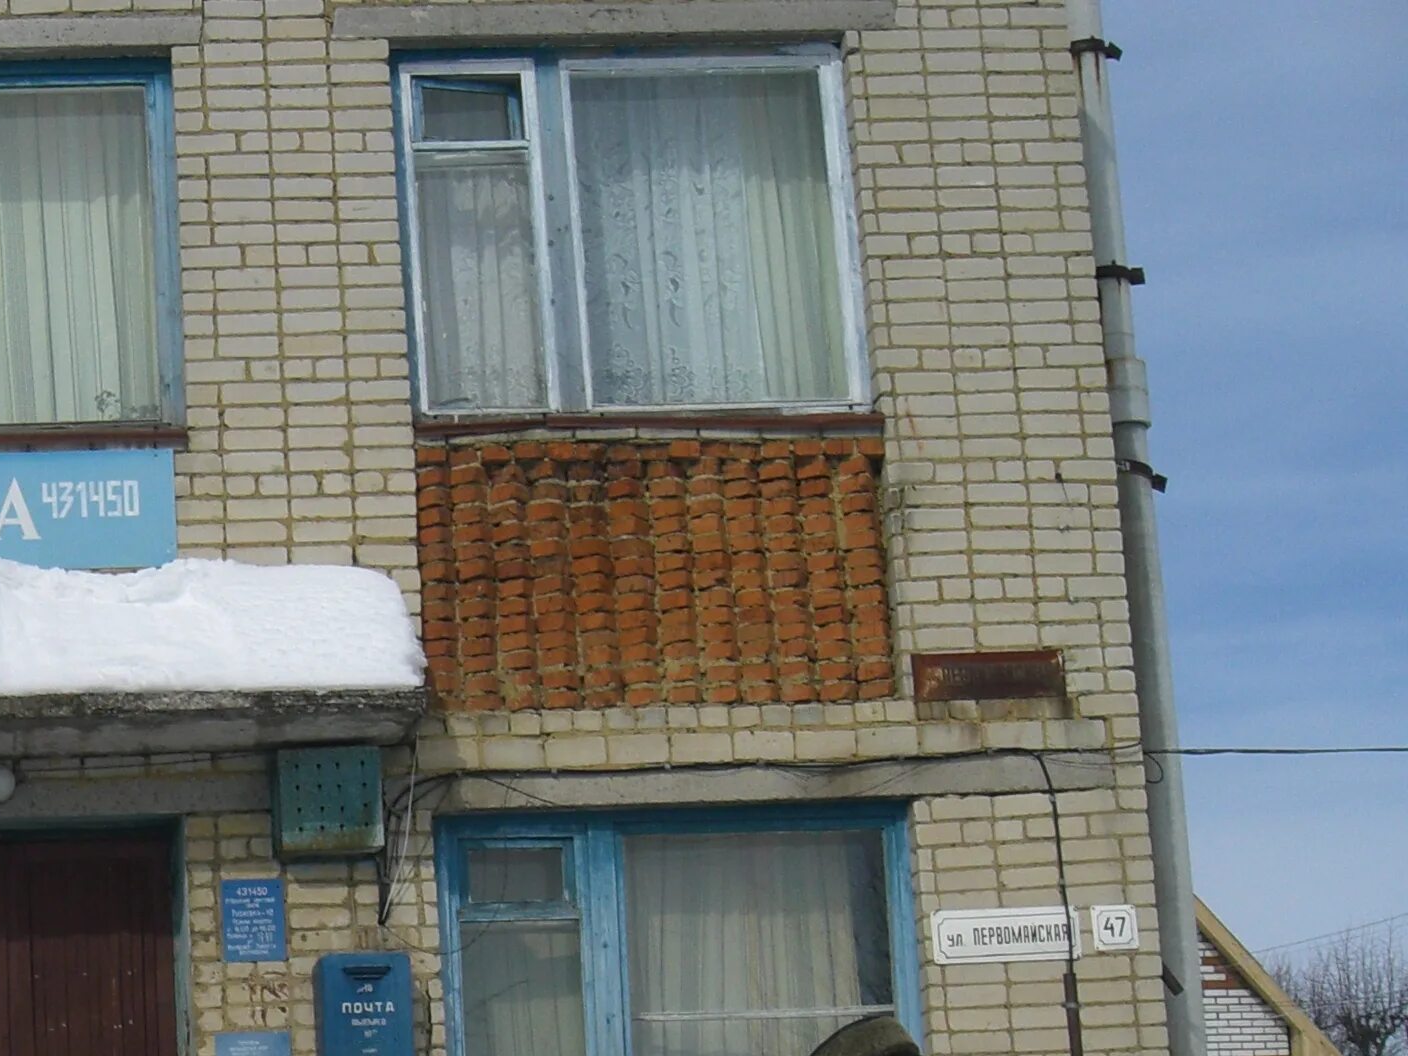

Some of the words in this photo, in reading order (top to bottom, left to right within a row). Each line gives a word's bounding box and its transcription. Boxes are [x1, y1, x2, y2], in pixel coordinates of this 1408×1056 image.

[41, 480, 140, 518] 431450
[236, 887, 268, 896] 431450
[973, 923, 1070, 946] ПЕРВОМАЙСКАЯ
[1103, 916, 1126, 938] 47
[341, 1001, 395, 1014] ПОЧТА
